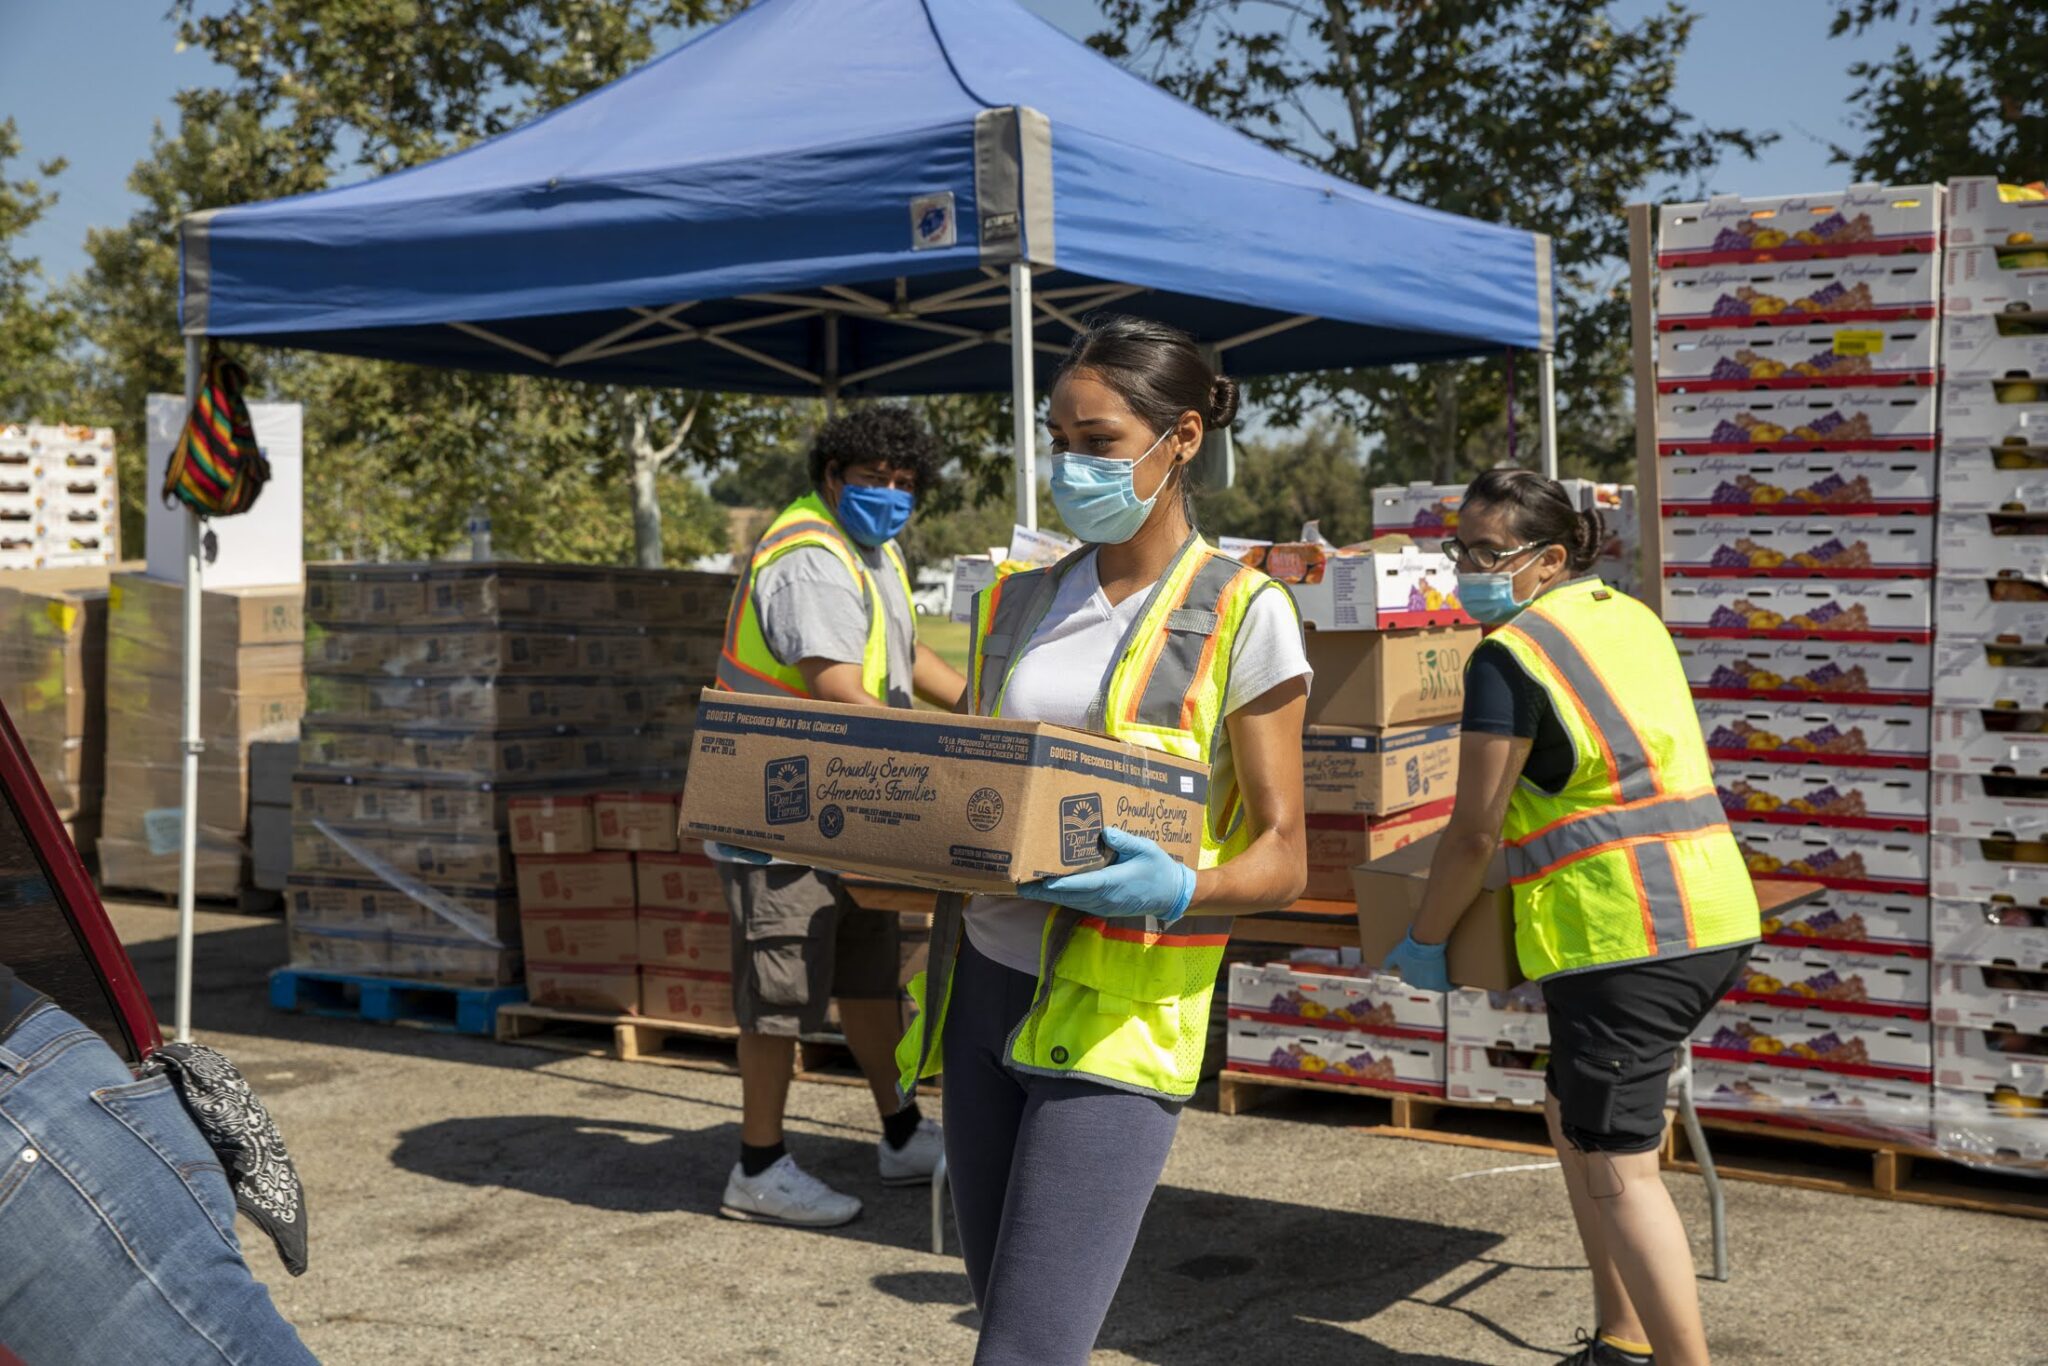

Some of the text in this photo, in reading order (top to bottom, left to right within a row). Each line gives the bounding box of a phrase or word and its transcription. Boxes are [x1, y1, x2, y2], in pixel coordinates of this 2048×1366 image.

[737, 713, 774, 727] PRECOOKED
[776, 716, 796, 729] MEAT
[797, 719, 812, 731] BOX
[813, 721, 848, 736] (CHICKEN)
[826, 756, 929, 783] Proudly Serving
[1080, 752, 1113, 769] PRECOOKED
[1114, 759, 1129, 774] MEAT
[1130, 764, 1142, 776] BOX
[816, 779, 937, 801] America's Families
[969, 790, 1002, 810] INSPECTED
[977, 805, 992, 815] U.S.
[1117, 796, 1187, 825] Proudly Serving
[1161, 822, 1192, 844] Families
